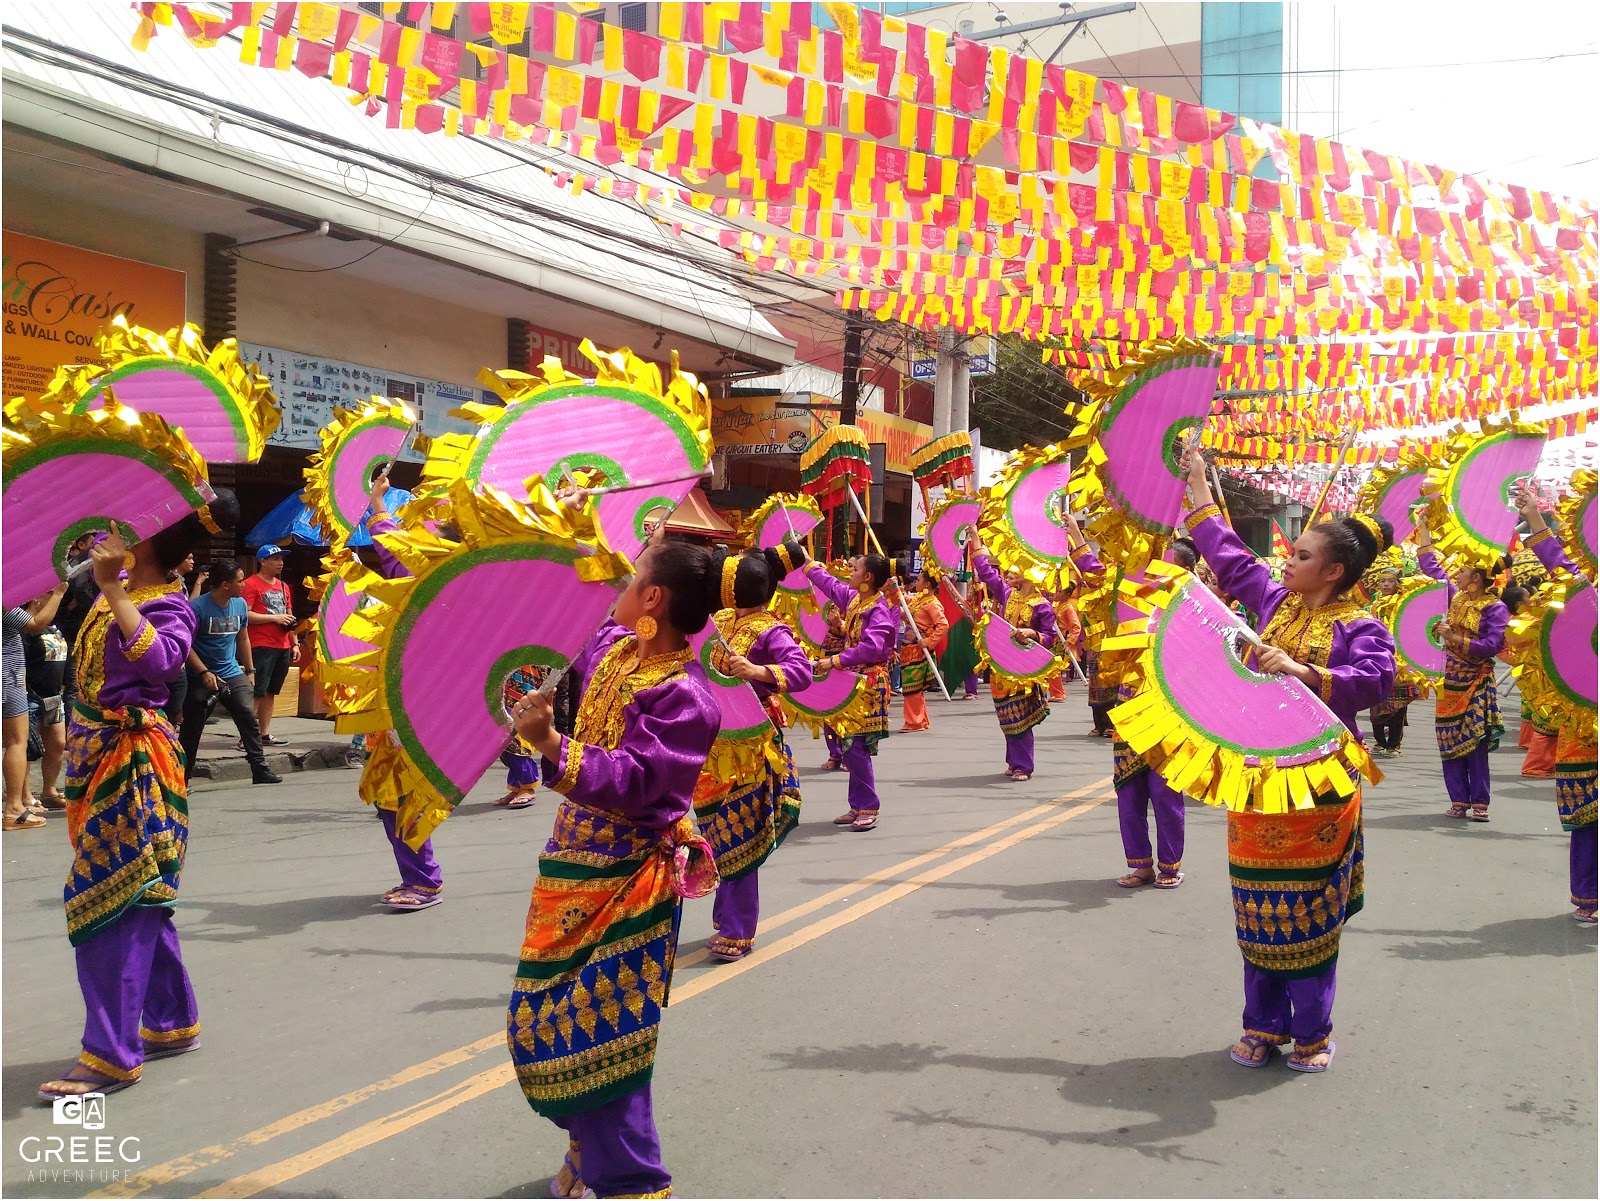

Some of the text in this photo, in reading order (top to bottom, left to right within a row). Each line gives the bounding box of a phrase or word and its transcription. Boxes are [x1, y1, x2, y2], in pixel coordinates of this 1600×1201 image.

[15, 261, 139, 326] Casa
[5, 319, 17, 335] &
[64, 330, 96, 348] COV
[436, 381, 442, 392] 5
[443, 383, 456, 396] Star
[456, 385, 474, 398] Hotel
[754, 444, 784, 454] EATERY
